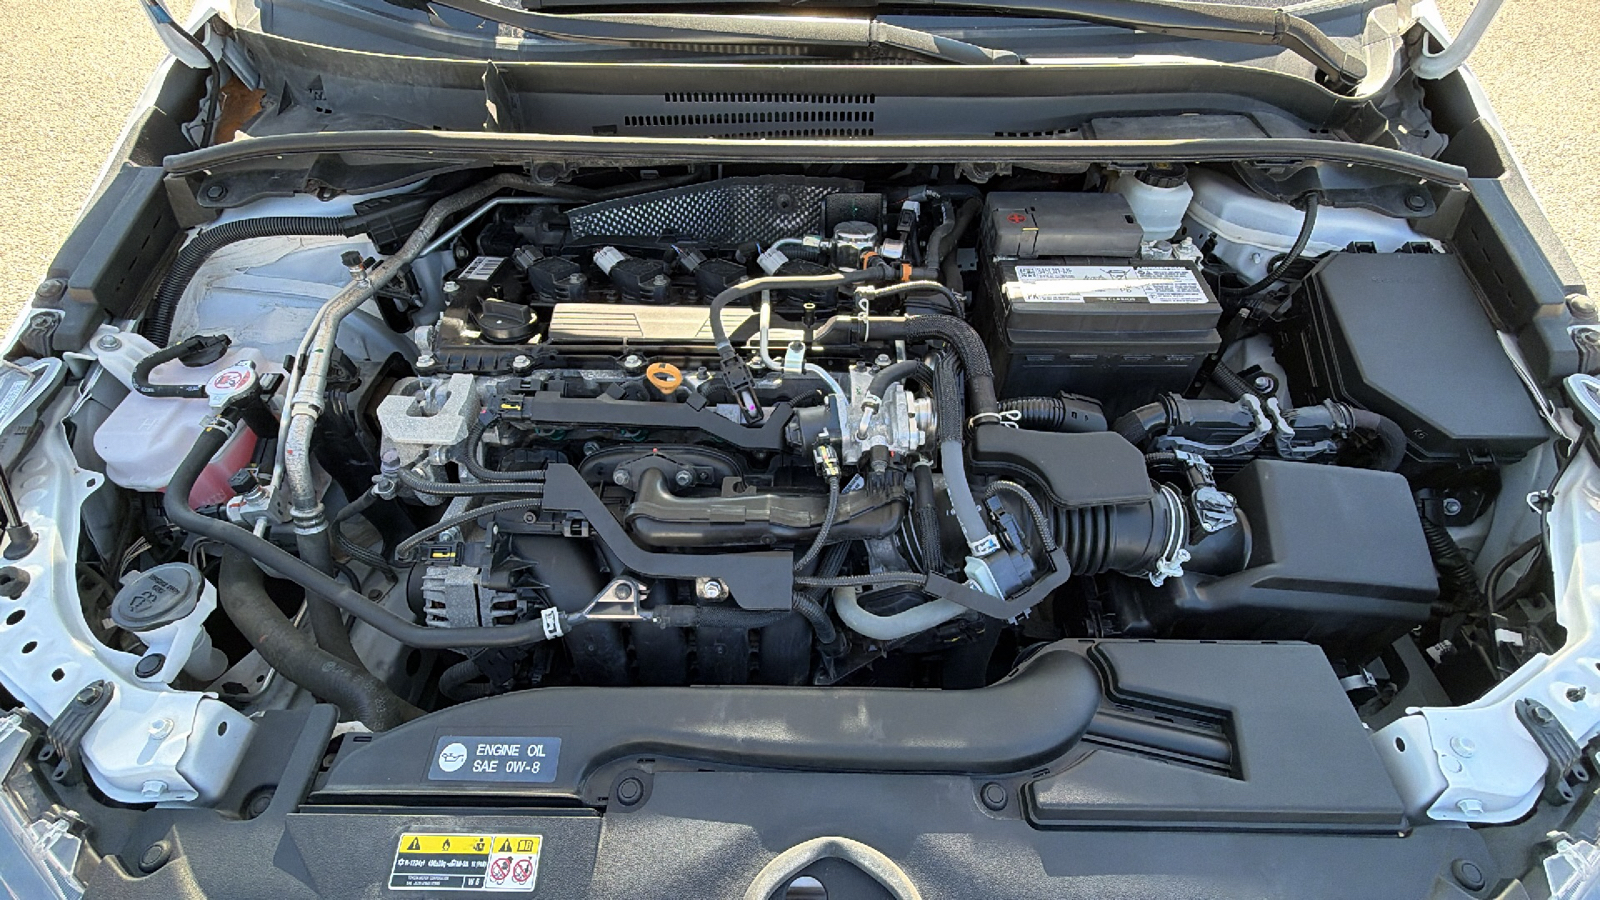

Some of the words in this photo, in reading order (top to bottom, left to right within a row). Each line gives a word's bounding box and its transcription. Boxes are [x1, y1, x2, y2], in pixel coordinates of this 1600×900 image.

[476, 743, 521, 756] ENGINE
[527, 744, 546, 757] OIL
[472, 759, 499, 773] SAE
[505, 760, 541, 774] 0W-8
